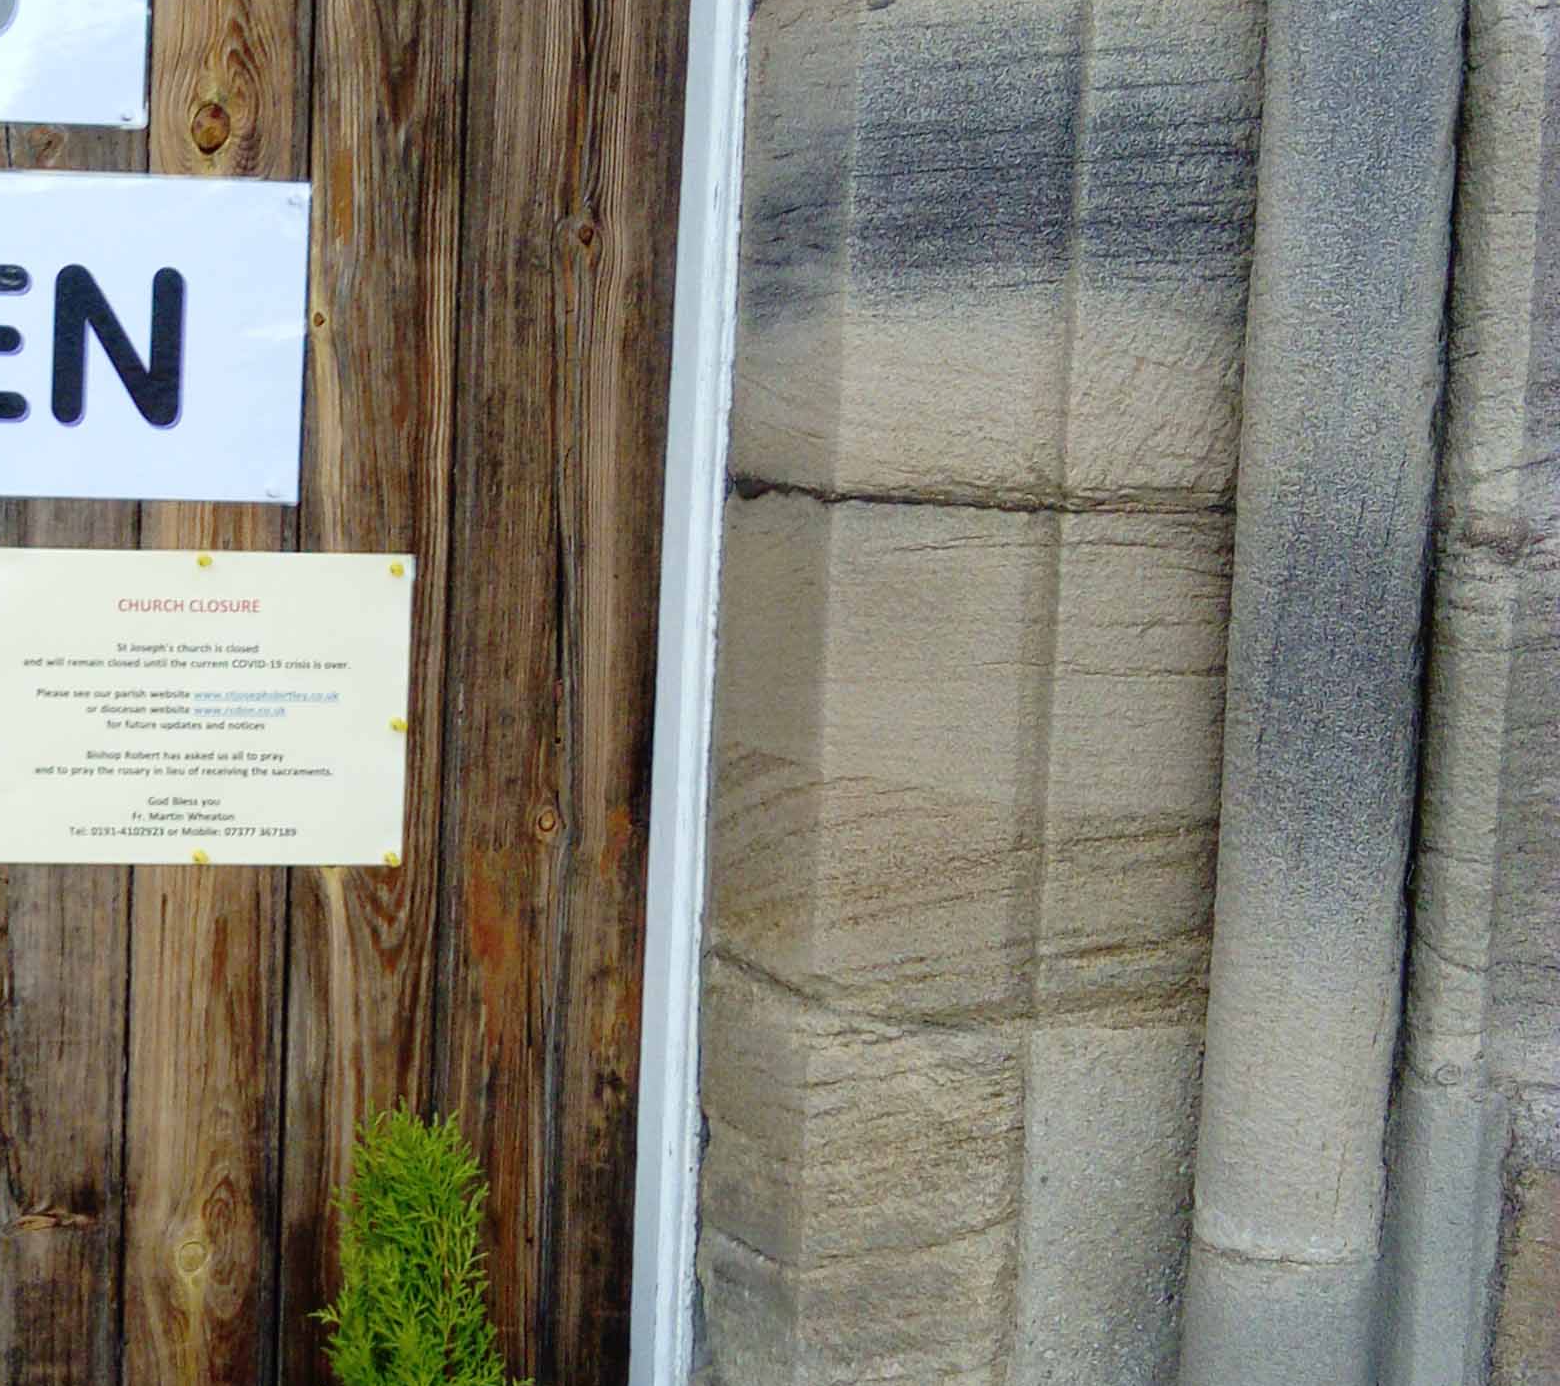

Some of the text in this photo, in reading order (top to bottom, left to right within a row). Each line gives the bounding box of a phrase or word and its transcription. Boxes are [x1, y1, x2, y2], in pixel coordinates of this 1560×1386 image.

[118, 599, 262, 614] CHURCH CLOSURE
[117, 643, 260, 655] St Joseph's church is closed
[24, 658, 43, 666] and
[46, 658, 64, 666] will
[67, 660, 104, 668] remain
[107, 659, 141, 668] closed
[144, 659, 168, 668] until
[170, 659, 187, 668] the
[190, 660, 228, 668] current
[231, 659, 282, 669] COVID-19
[285, 661, 310, 669] crisis
[313, 661, 322, 670] is
[36, 689, 70, 698] Please
[114, 690, 147, 701] parish
[150, 691, 191, 699] website
[100, 705, 147, 714] diocesan
[149, 706, 190, 714] website
[106, 720, 266, 732] for future updates and notices
[85, 751, 284, 764] Bishop Robert has asked us all to pray
[35, 766, 332, 778] and to pray the rosary in lieu of receiving the sacraments.
[148, 797, 221, 809] God Bless you
[148, 813, 184, 822] Martin
[167, 829, 178, 837] or
[181, 827, 221, 836] Mobile:
